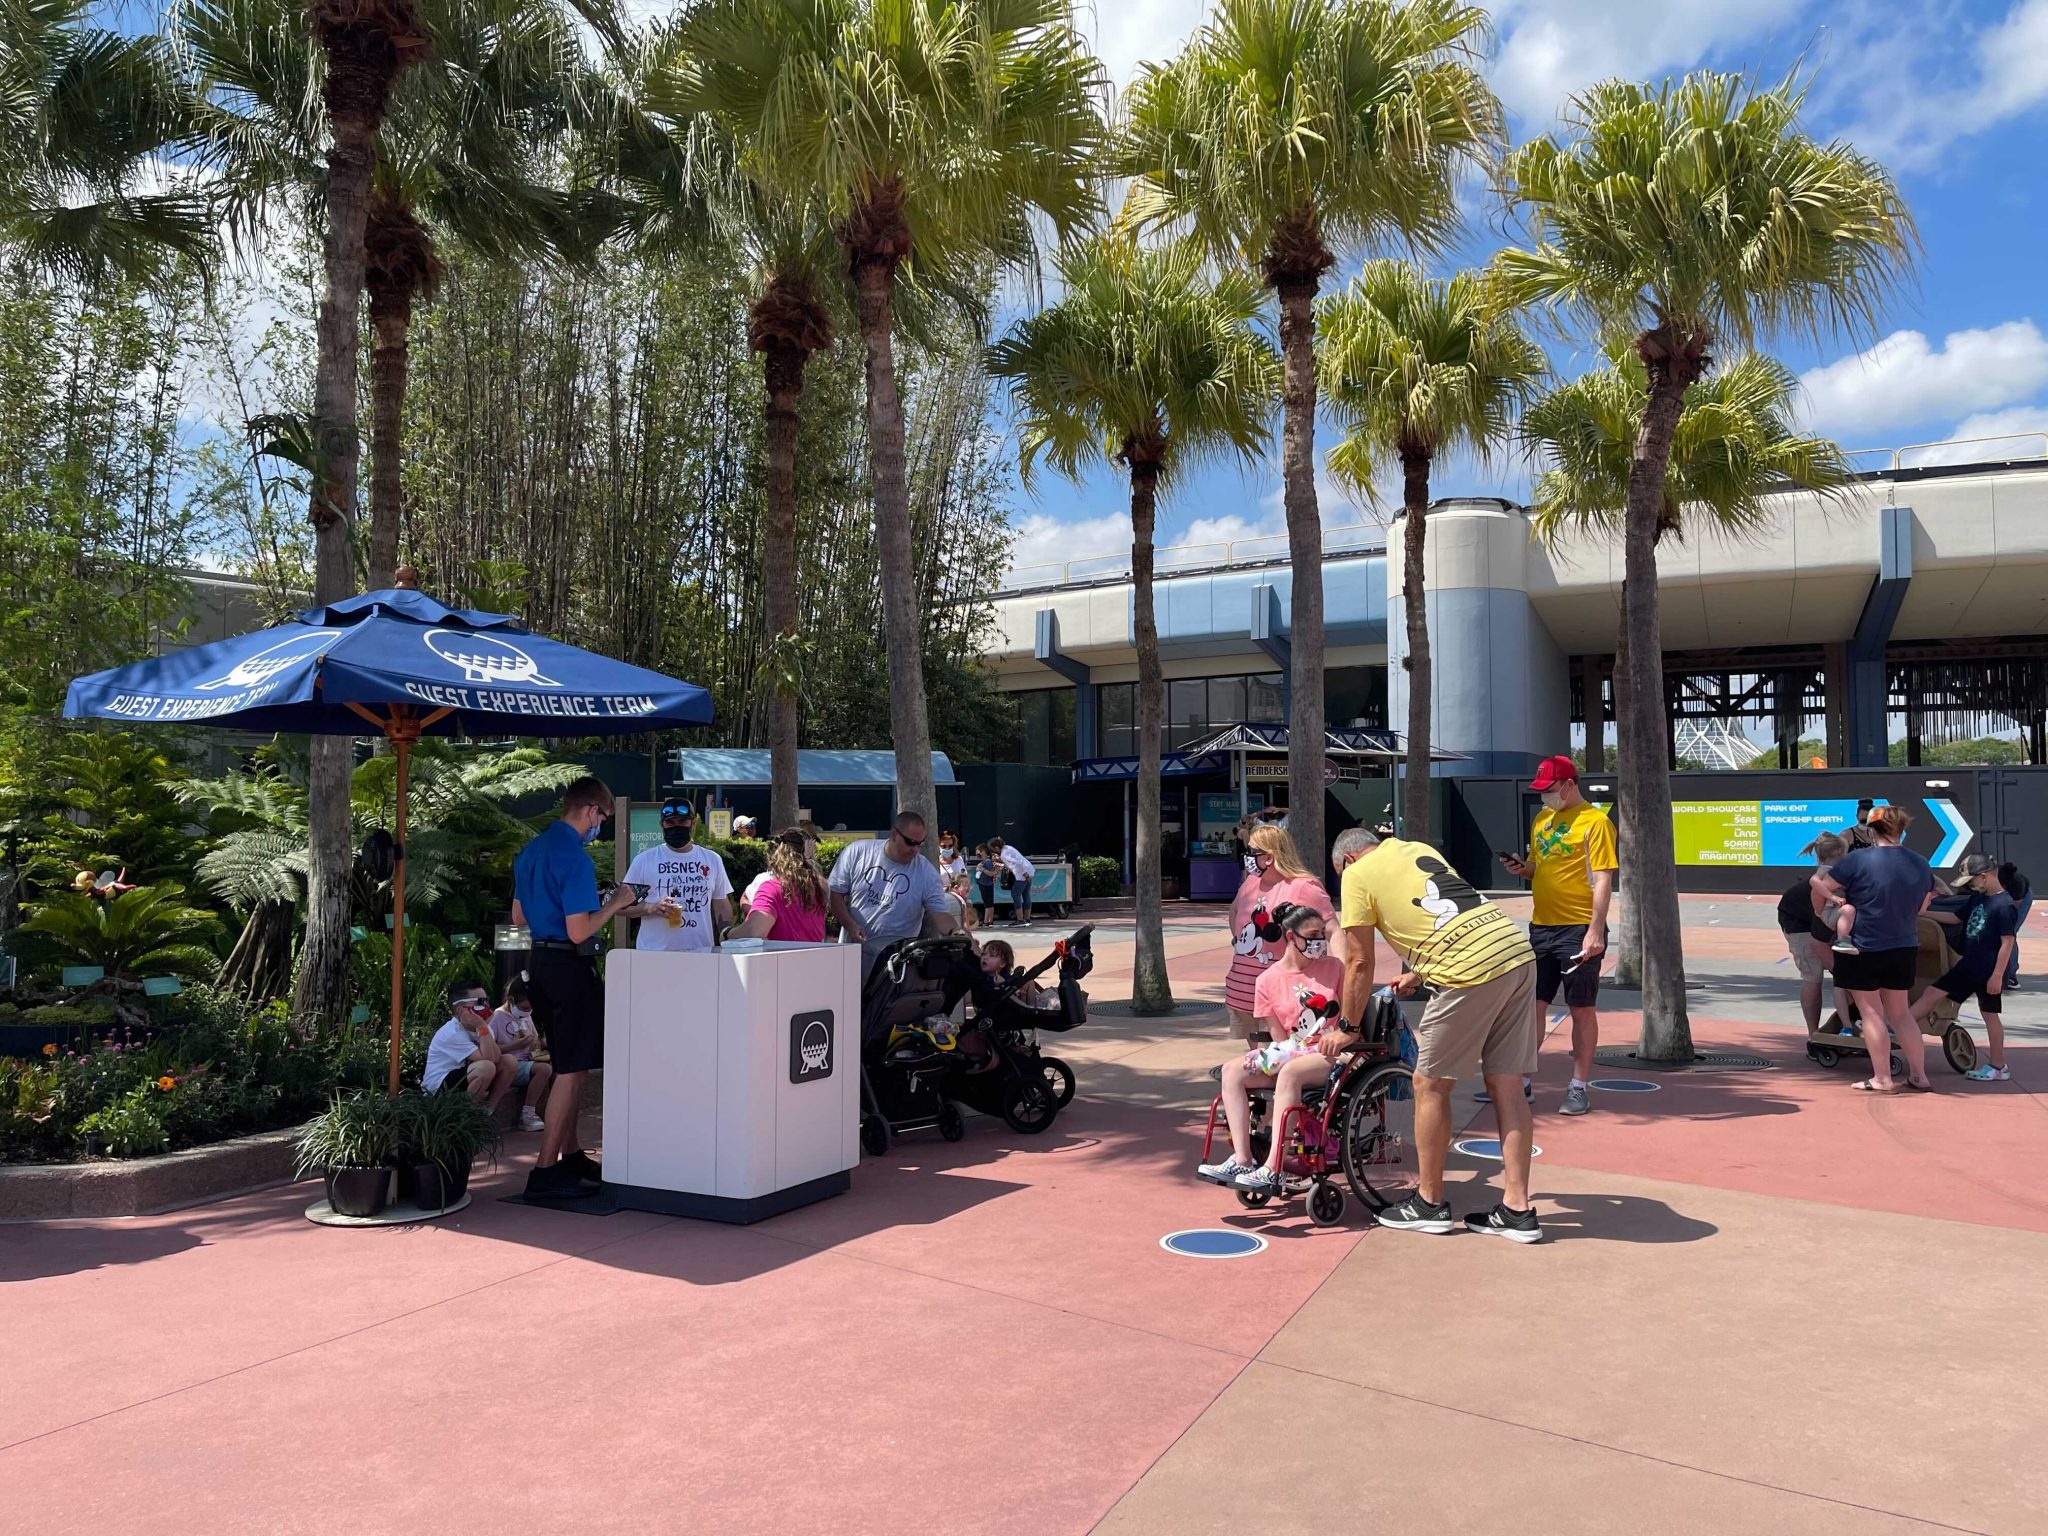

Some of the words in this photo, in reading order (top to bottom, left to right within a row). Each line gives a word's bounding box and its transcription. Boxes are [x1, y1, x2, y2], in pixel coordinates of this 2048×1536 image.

[405, 682, 471, 708] GUEST
[476, 691, 600, 715] EXPERIENCE
[602, 696, 659, 715] TEAM
[104, 694, 160, 717] GUEST
[156, 693, 247, 719] EXPERIENCE
[1246, 765, 1289, 777] MEMBERSH
[1672, 805, 1705, 813] WORLD
[1706, 805, 1757, 813] SHOWCASE
[1764, 804, 1788, 812] PARK
[1788, 804, 1808, 812] EXIT
[1734, 816, 1758, 824] SEAS
[1813, 815, 1843, 823] EARTH
[1734, 830, 1758, 838] LAND
[1699, 852, 1759, 861] IMAGINATION
